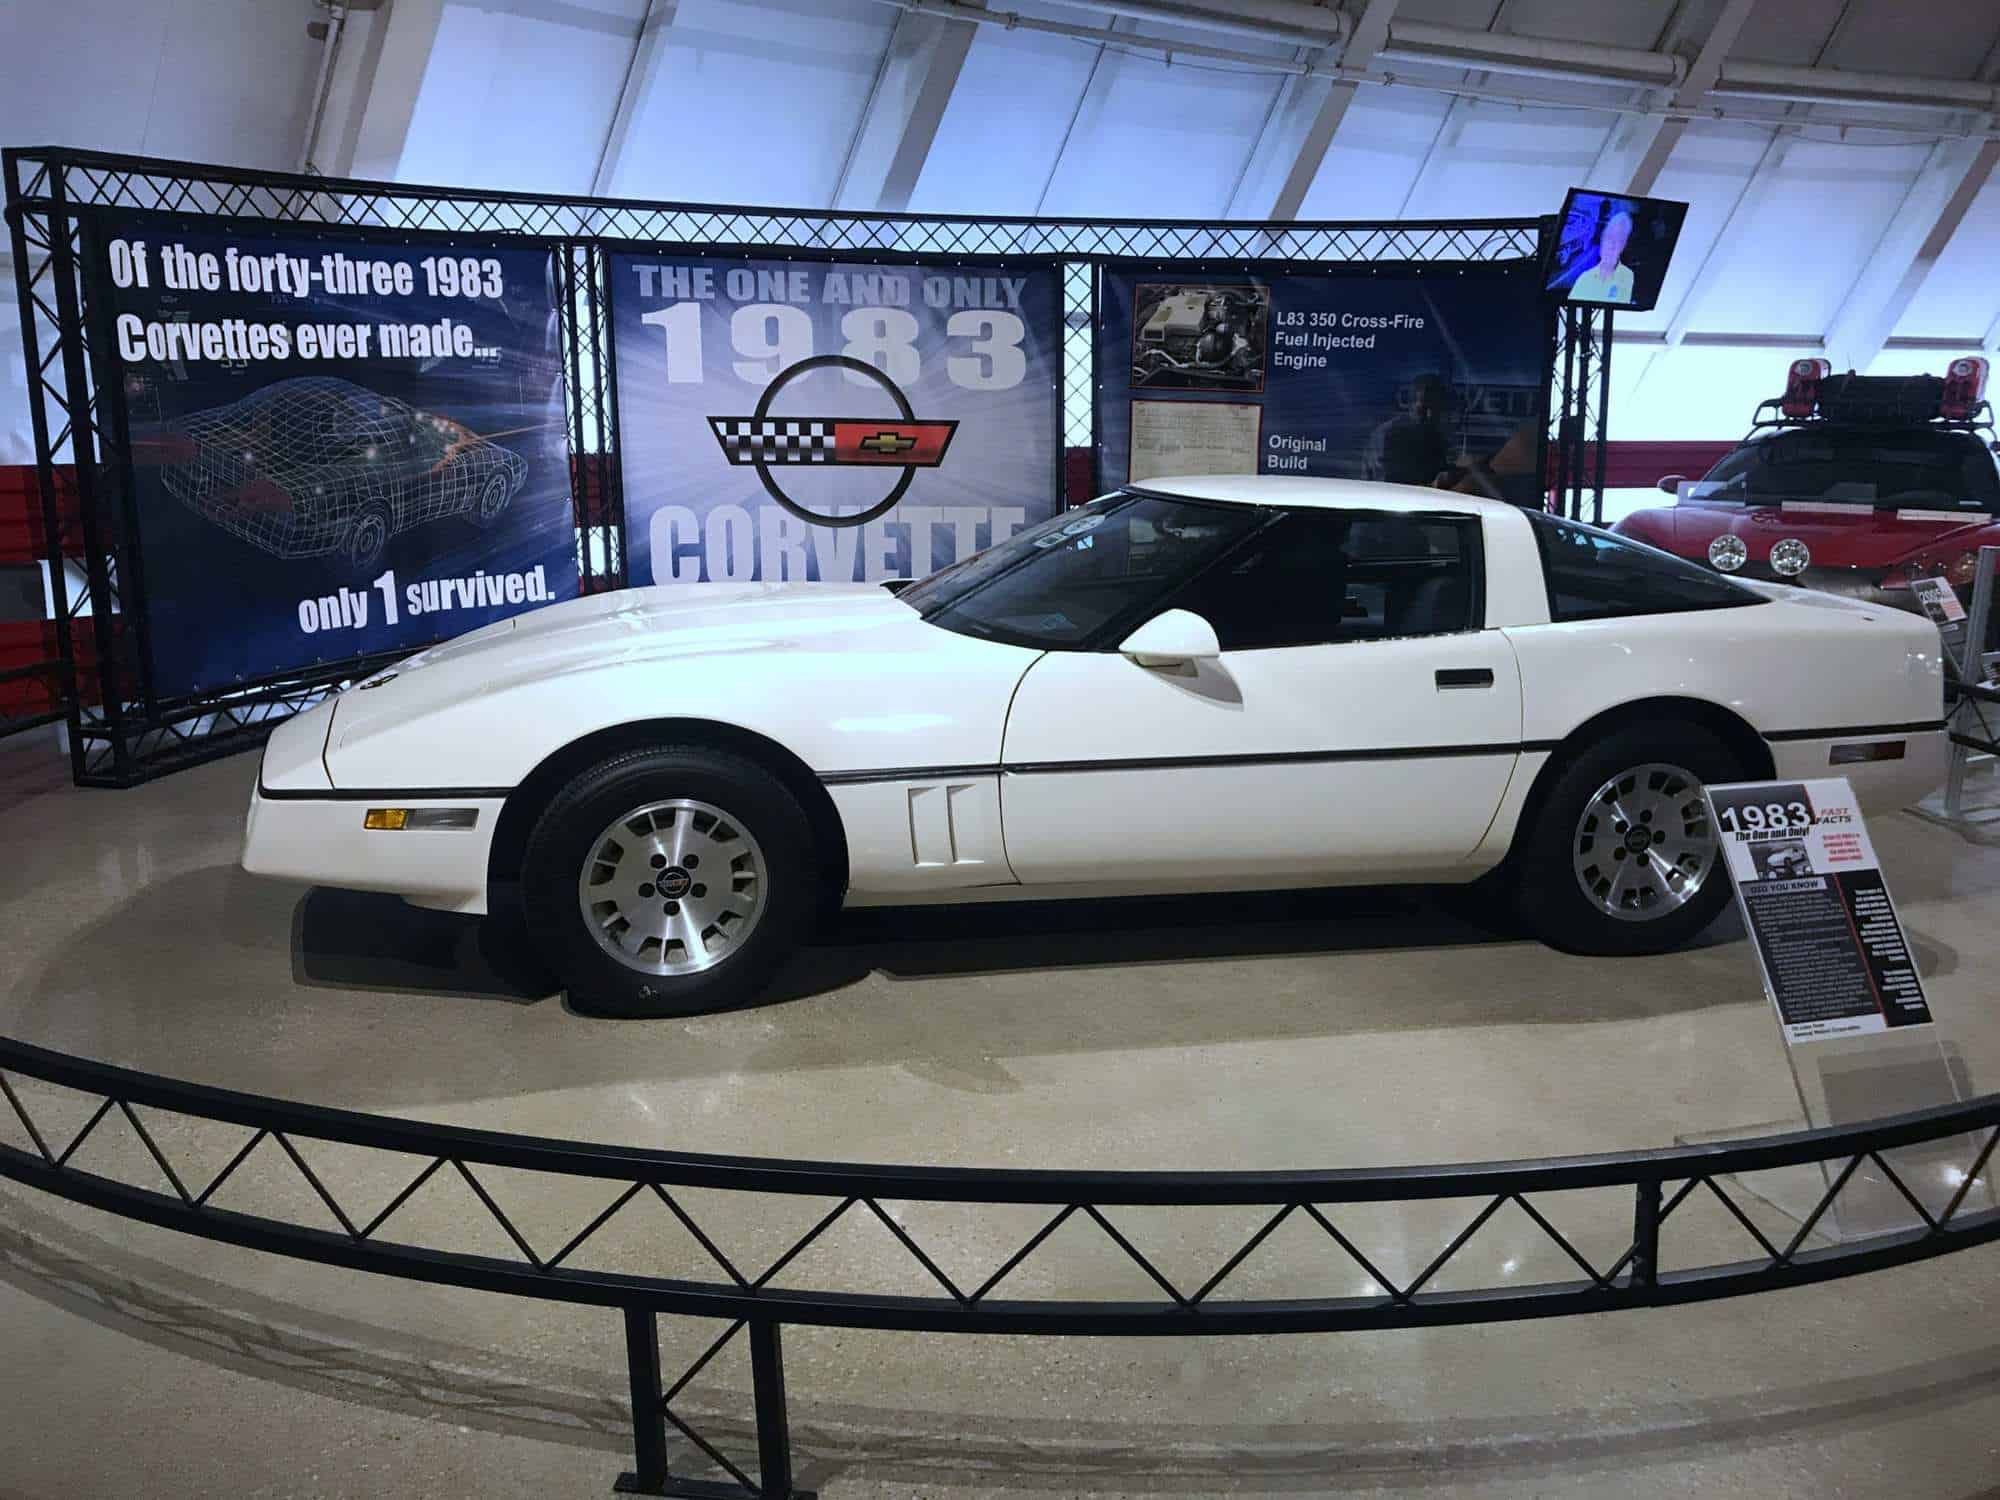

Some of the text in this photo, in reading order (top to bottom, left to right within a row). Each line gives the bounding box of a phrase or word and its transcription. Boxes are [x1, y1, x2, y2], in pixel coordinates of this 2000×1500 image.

[109, 239, 503, 298] Of the forty-three 1983
[632, 264, 1027, 308] THE ONE AND ONLY
[1276, 311, 1425, 329] L83 350 Cross-Fire
[116, 313, 498, 362] Corvettes ever made...
[641, 302, 1027, 392] 1983
[1275, 331, 1376, 351] Fuel Injected
[1274, 351, 1328, 370] Engine
[1268, 434, 1327, 453] Original
[1267, 454, 1309, 471] Build
[298, 564, 556, 634] only 1 survived.
[1721, 802, 1812, 833] 1983
[1815, 815, 1852, 825] FACTS
[1735, 832, 1751, 842] The
[1770, 828, 1787, 839] and
[1751, 879, 1819, 894] DID YOU KNOW
